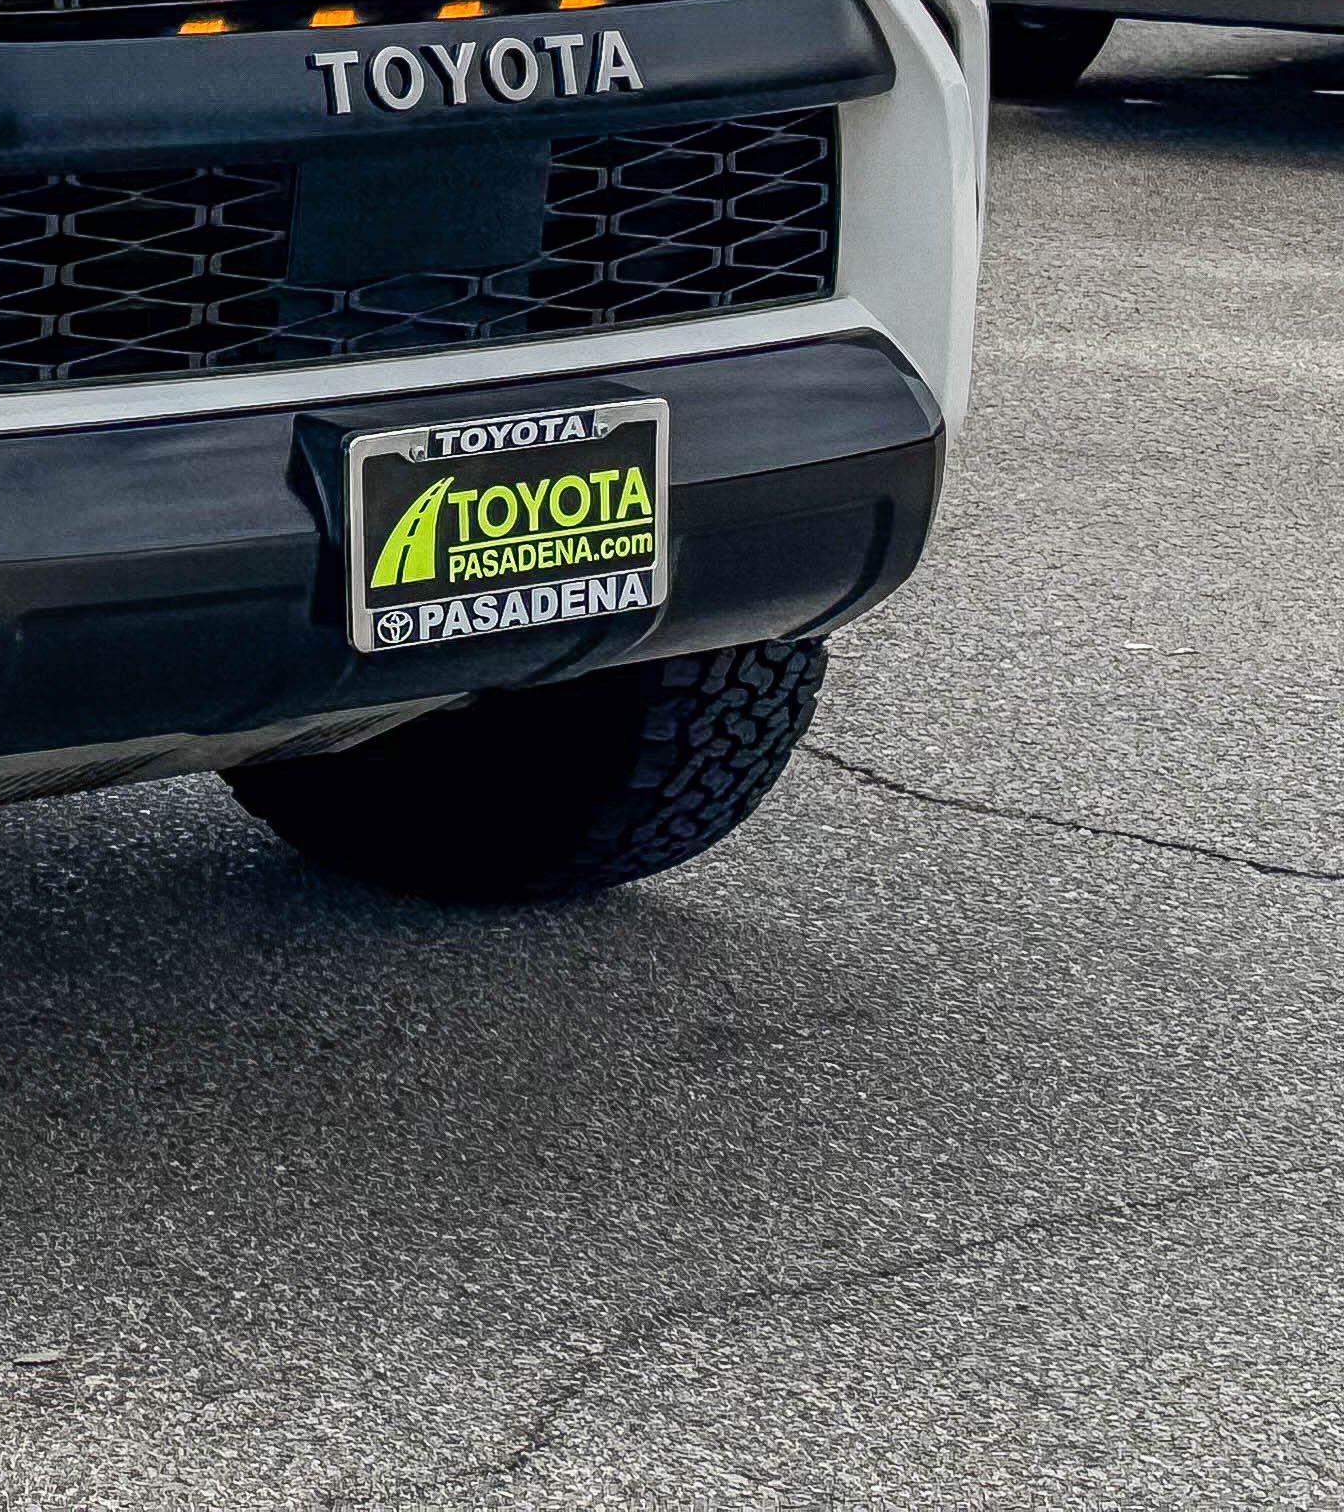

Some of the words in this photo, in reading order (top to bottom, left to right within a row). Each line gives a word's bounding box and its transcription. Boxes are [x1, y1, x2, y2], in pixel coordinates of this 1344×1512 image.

[308, 30, 644, 114] TOYOTA
[436, 415, 586, 456] TOYOTA
[448, 466, 652, 543] TOYOTA
[449, 532, 654, 583] PASADENA.com
[419, 573, 648, 640] PASADENA
